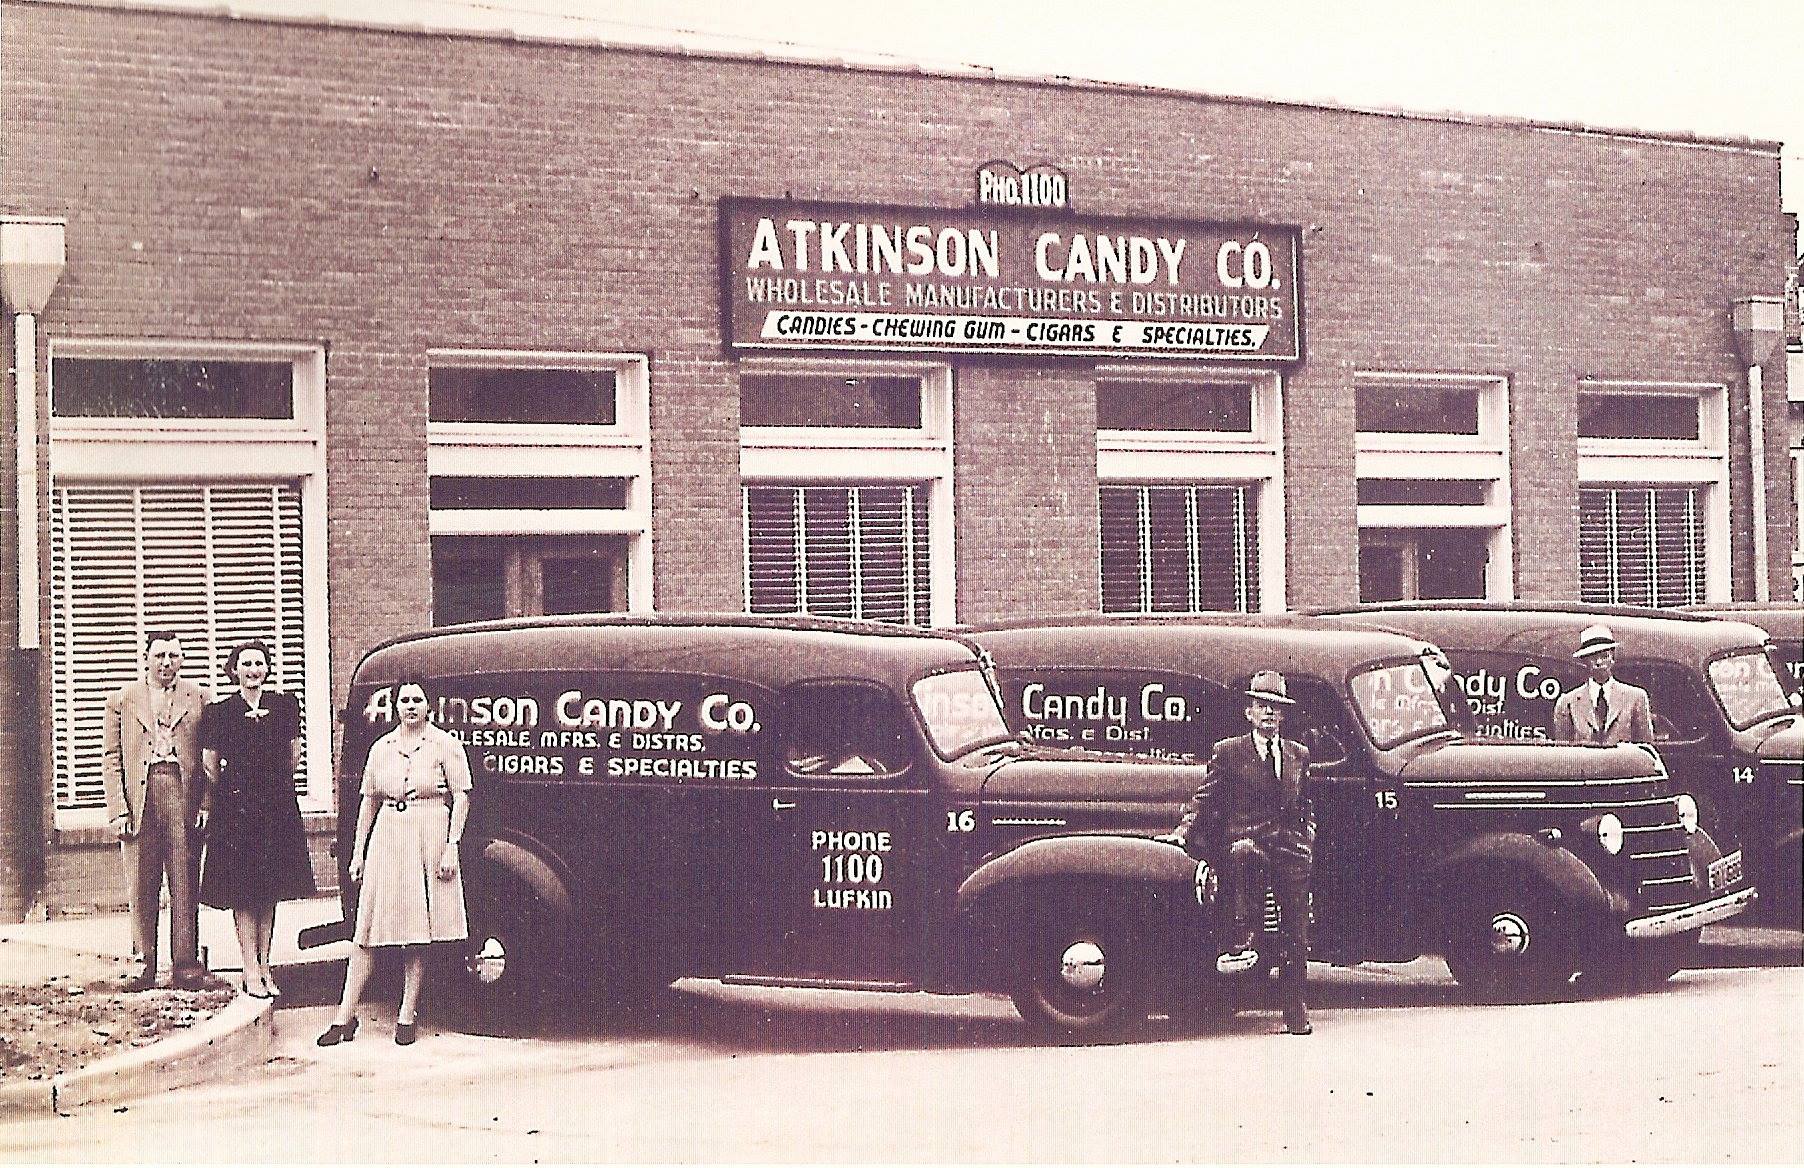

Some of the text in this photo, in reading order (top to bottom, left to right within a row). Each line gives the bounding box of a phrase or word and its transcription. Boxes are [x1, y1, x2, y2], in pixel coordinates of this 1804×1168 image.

[747, 217, 1281, 289] ATKINSON CANDY CO.
[746, 277, 892, 306] WHOLESALE
[905, 282, 1101, 313] MANUFACTURERS
[1132, 292, 1283, 319] DISTRIBUTORS
[777, 314, 856, 336] CANDIES
[872, 318, 956, 338] CHEWING
[963, 321, 1005, 341] GUM
[1026, 323, 1095, 342] CIGARS
[1142, 326, 1256, 347] SPECIALTIES.
[363, 686, 539, 727] AINSON
[556, 690, 681, 730] CANDY
[1022, 682, 1127, 727] Candy
[449, 729, 530, 748] LESALE
[540, 731, 601, 749] MFRS.
[483, 754, 564, 775] CIGARS
[608, 757, 758, 781] SPECIALTIES
[1732, 767, 1754, 784] 14
[1375, 791, 1397, 809] 15
[948, 810, 975, 833] 16
[811, 830, 892, 853] PHONE
[821, 854, 884, 884] 1100
[813, 888, 893, 910] LUFKIN
